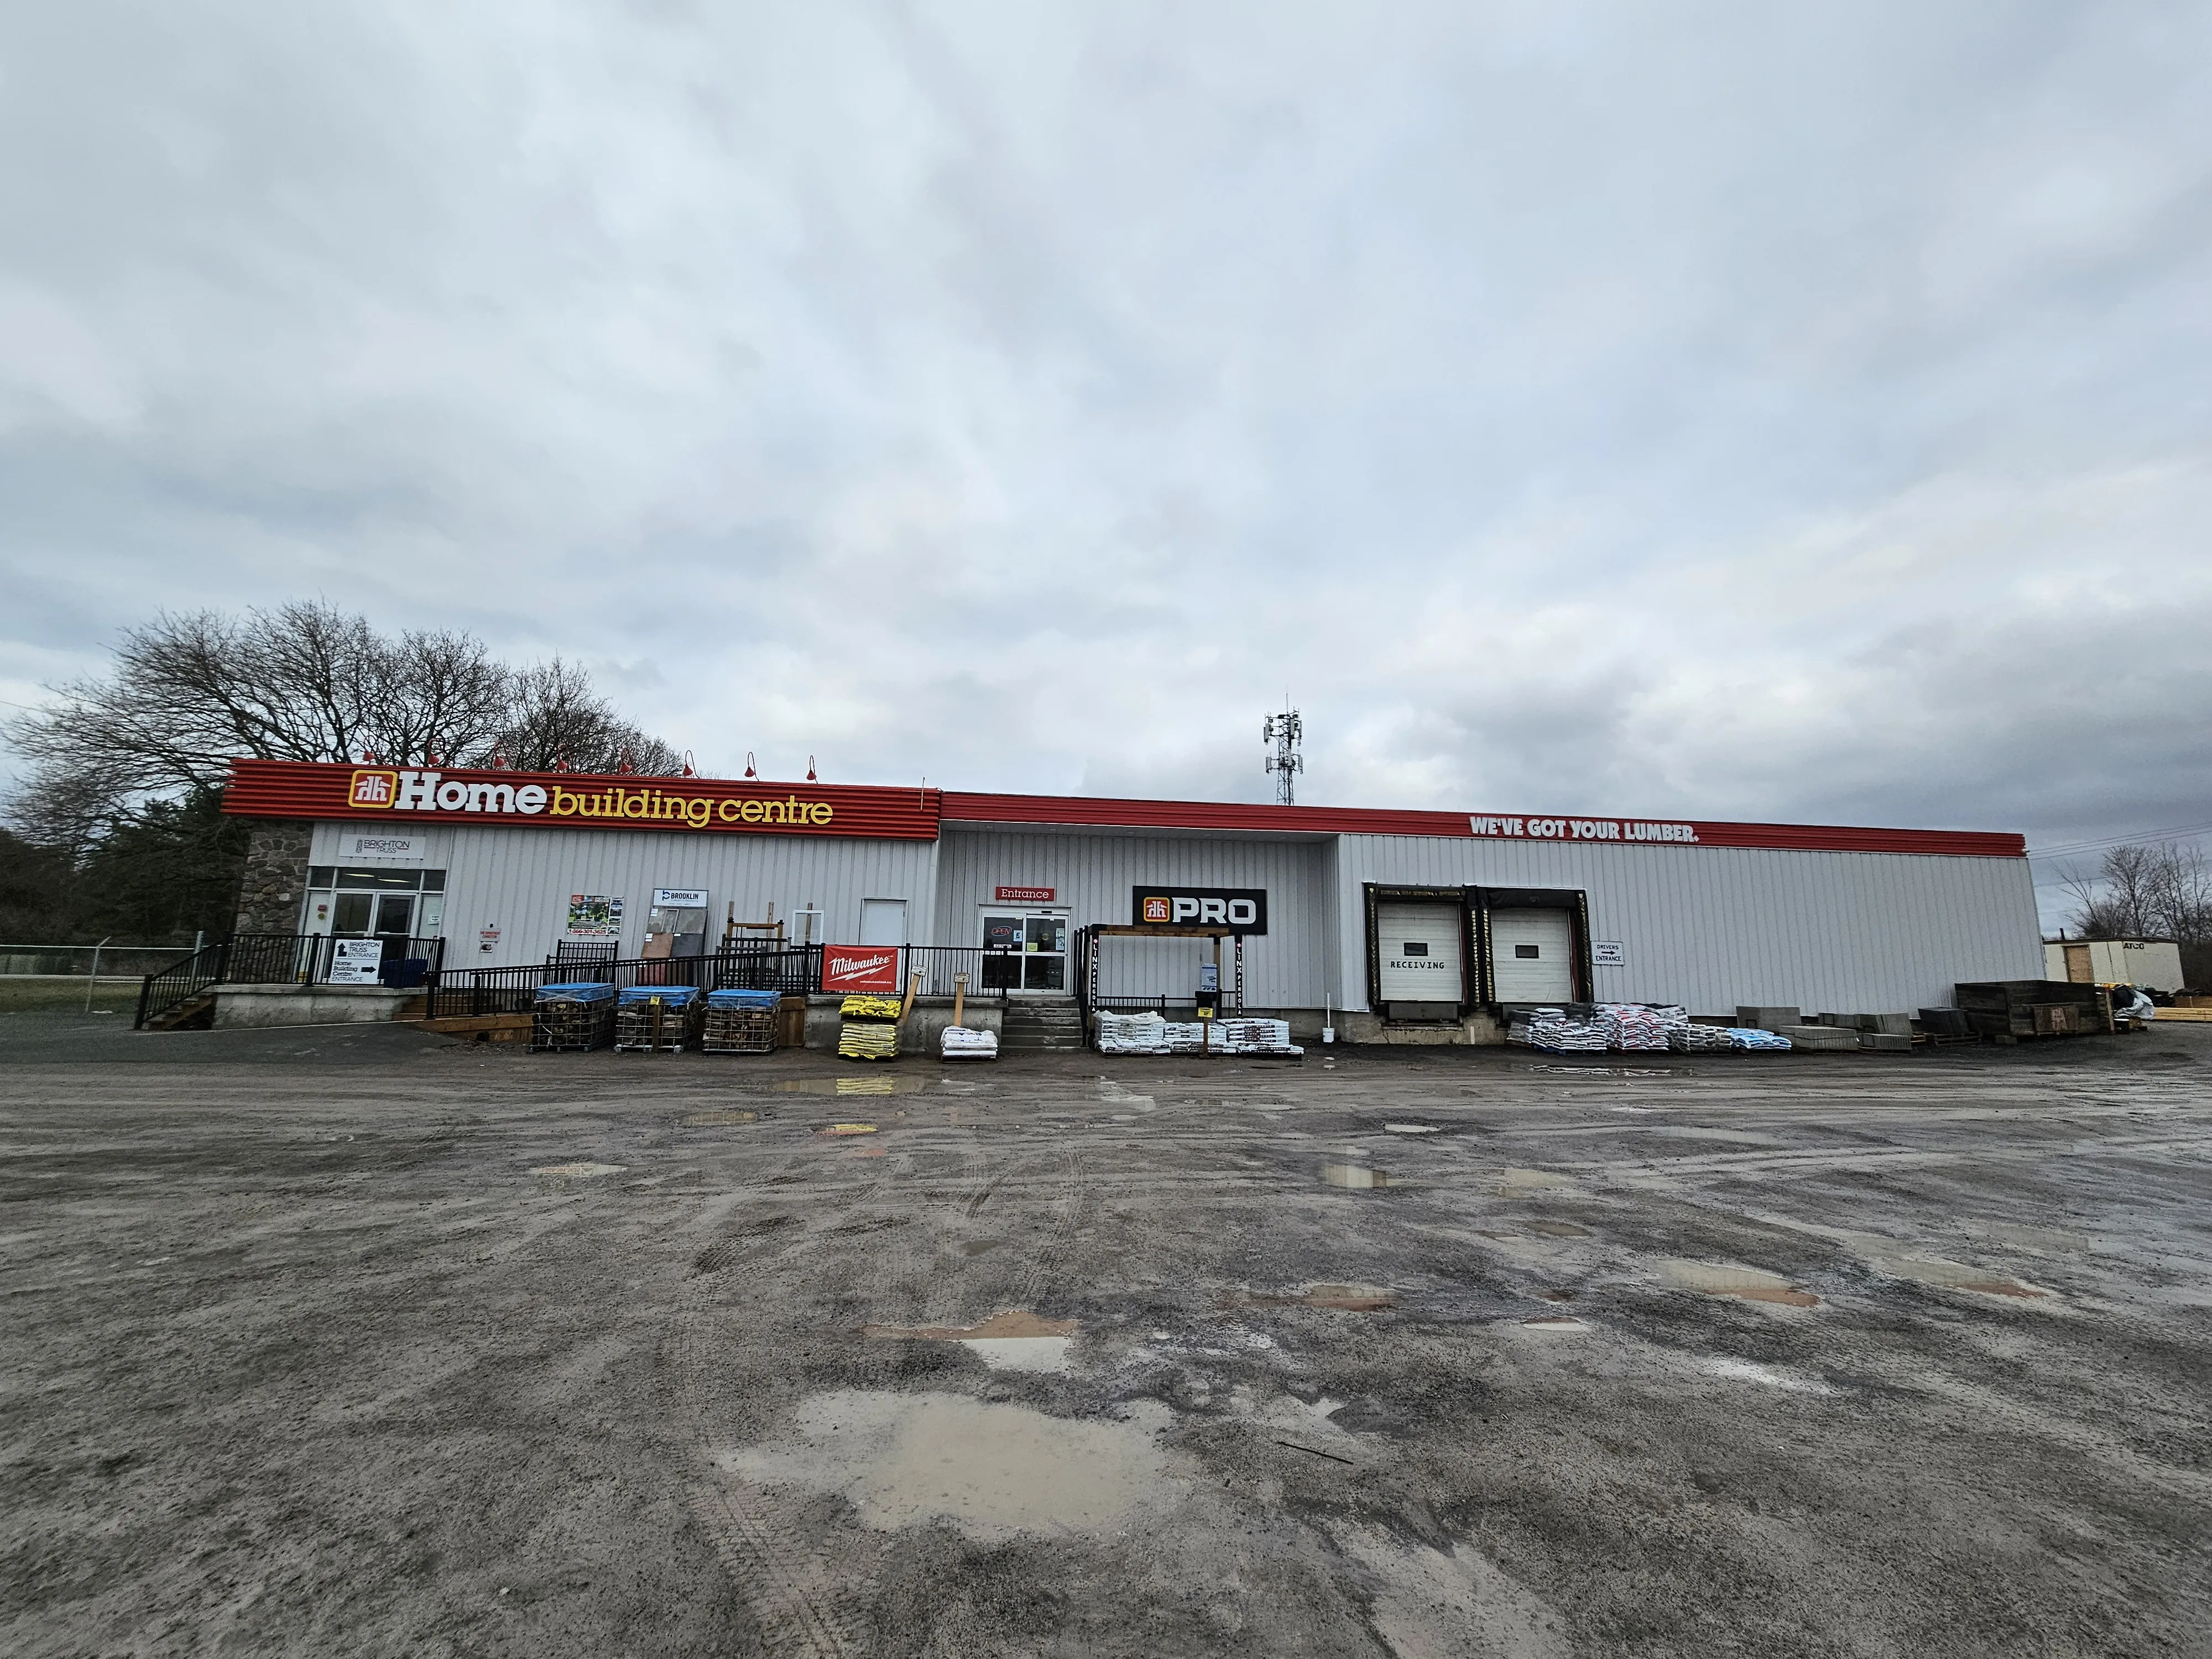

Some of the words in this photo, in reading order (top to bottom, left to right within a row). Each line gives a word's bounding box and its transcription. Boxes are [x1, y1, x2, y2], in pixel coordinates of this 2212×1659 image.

[394, 771, 547, 814] Home
[550, 786, 715, 828] building
[718, 795, 833, 825] centre
[1469, 816, 1524, 836] WE'VE
[1527, 819, 1566, 837] GOT
[1569, 821, 1620, 839] YOUR
[1624, 822, 1699, 842] LUMBER.
[364, 839, 410, 848] BRIGHTON
[1001, 889, 1049, 899] Entrance
[1171, 897, 1256, 924] PRO
[828, 954, 890, 975] Milwaukee
